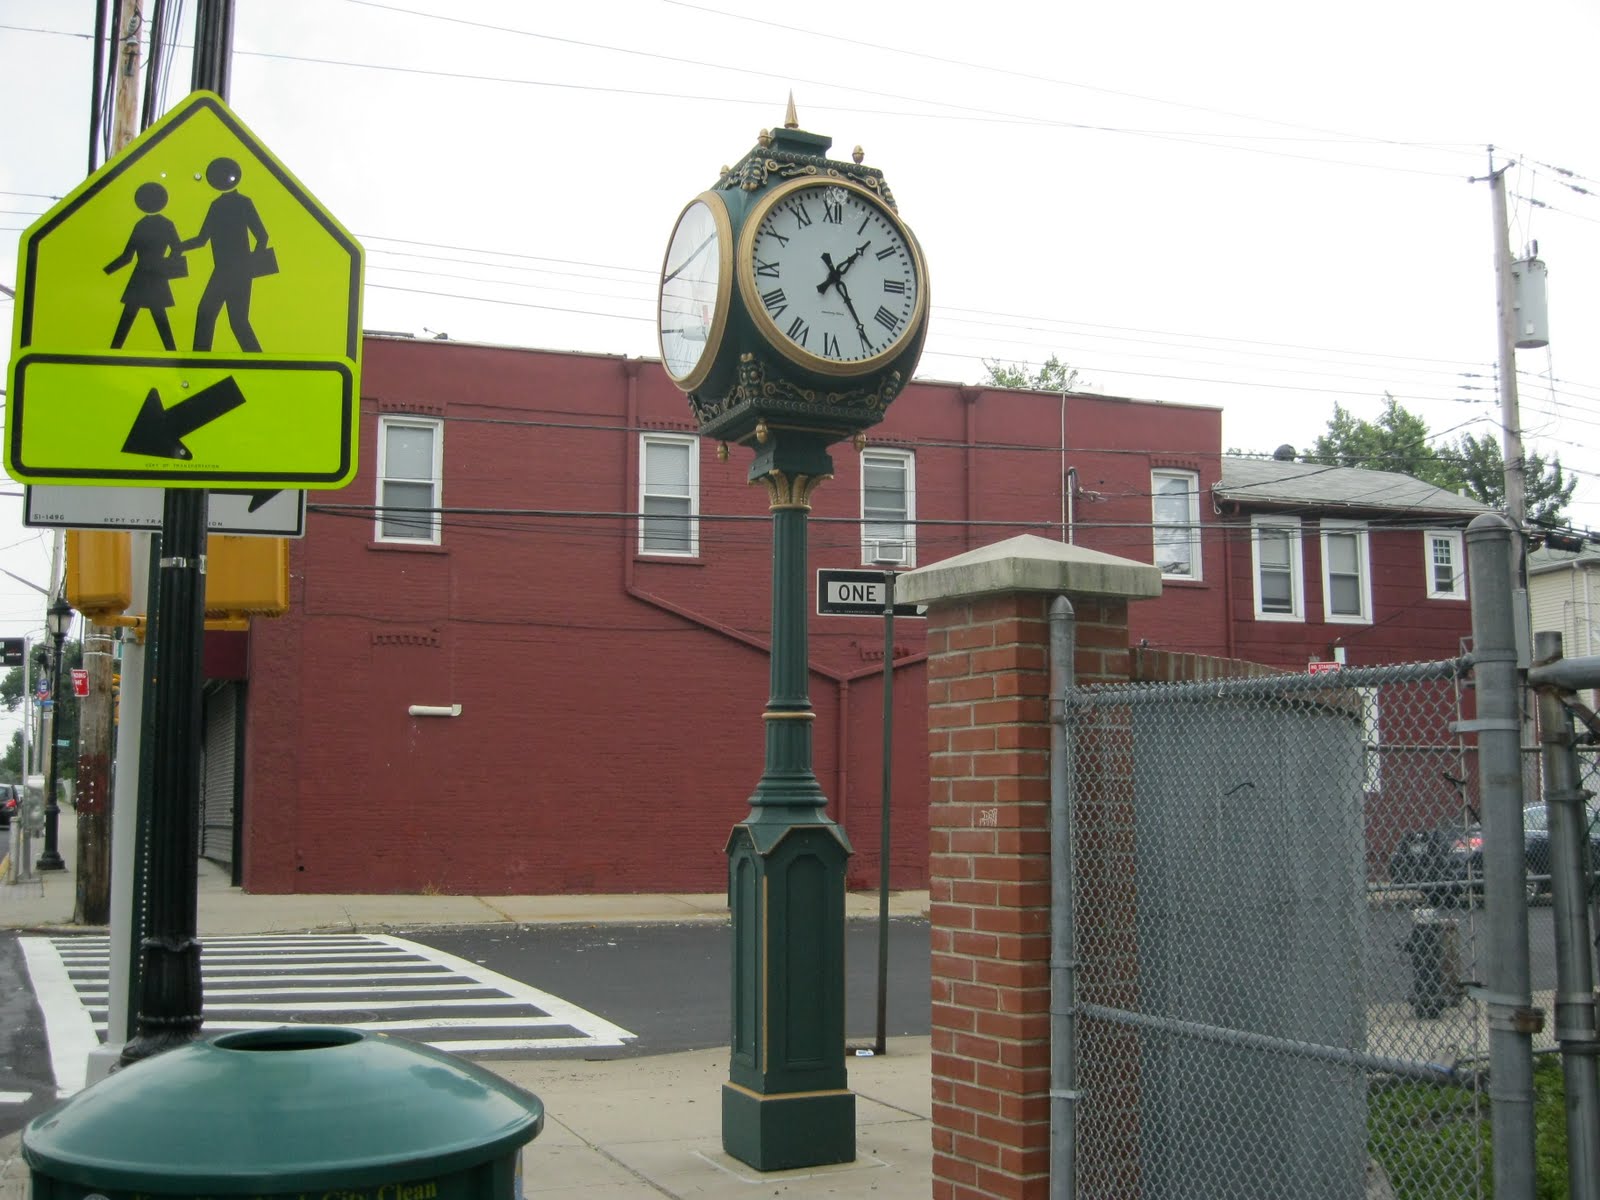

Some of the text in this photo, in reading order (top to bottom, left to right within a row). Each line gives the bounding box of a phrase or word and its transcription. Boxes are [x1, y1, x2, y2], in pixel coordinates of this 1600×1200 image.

[789, 201, 813, 230] XI
[822, 199, 844, 225] XII
[765, 225, 790, 248] X
[857, 215, 871, 236] I
[875, 245, 897, 261] II
[756, 259, 780, 279] IX
[883, 278, 906, 295] III
[761, 288, 789, 321] VIII
[786, 316, 810, 348] VII
[823, 332, 841, 358] VI
[838, 584, 876, 602] ONE
[377, 1182, 437, 1200] Clean
